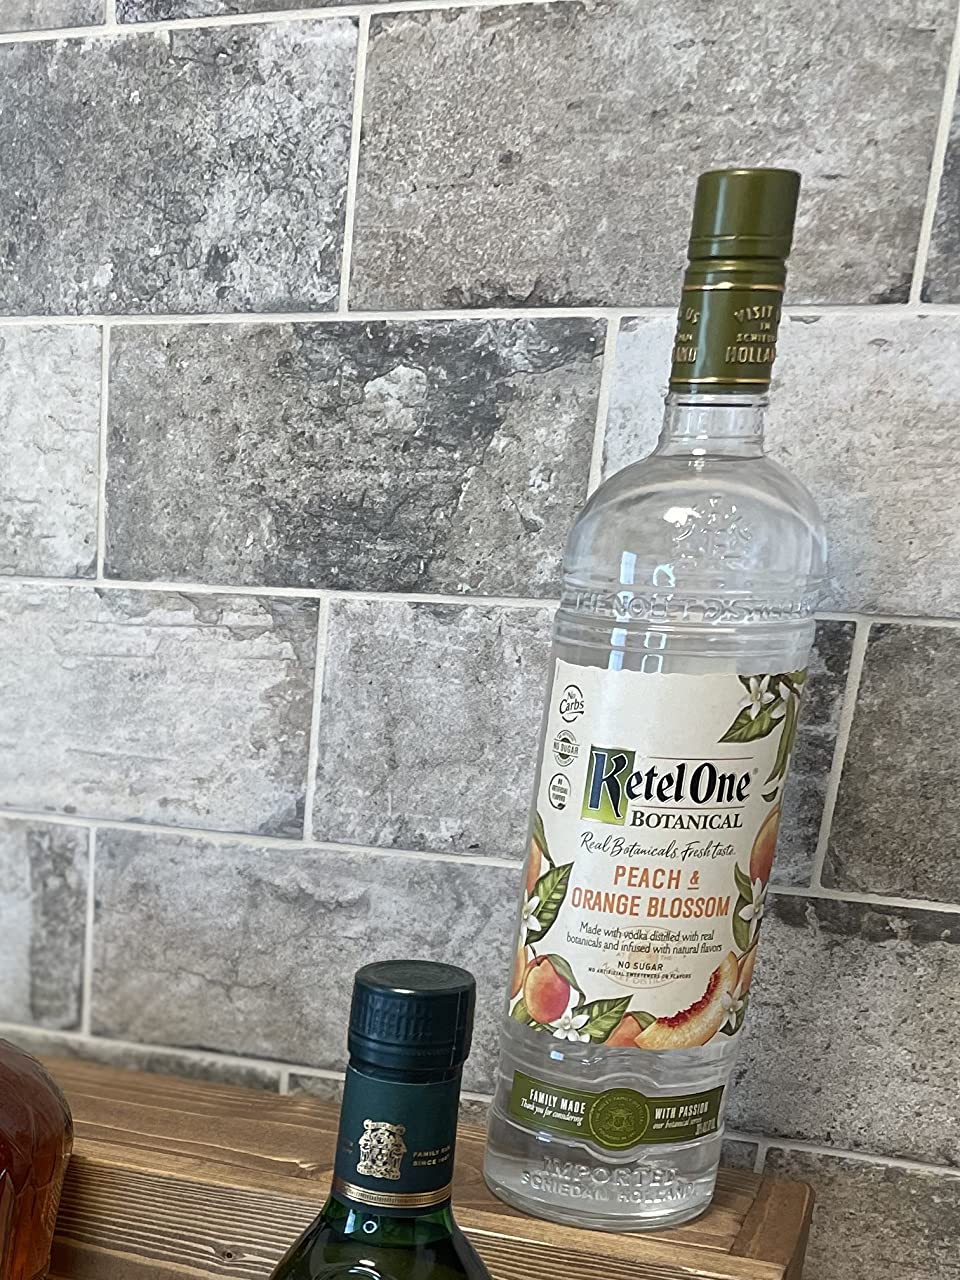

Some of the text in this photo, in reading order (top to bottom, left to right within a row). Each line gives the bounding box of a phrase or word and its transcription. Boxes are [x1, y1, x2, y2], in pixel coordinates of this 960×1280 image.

[559, 699, 585, 715] Carbs
[561, 743, 579, 755] SUGAR
[589, 751, 686, 819] Ketel
[630, 810, 743, 830] BOTANICAL
[580, 831, 612, 853] Real
[678, 840, 711, 862] Fresh
[613, 865, 700, 890] PEACH &
[571, 887, 731, 918] ORANGE BLOSSOM
[579, 921, 714, 942] Made with vodka distilled with real
[566, 932, 722, 955] botanicals and infused with natural flavors
[617, 960, 663, 971] NO SUGAR
[529, 1089, 586, 1114] FAMILY MADE
[655, 1101, 709, 1119] WITH PASSION
